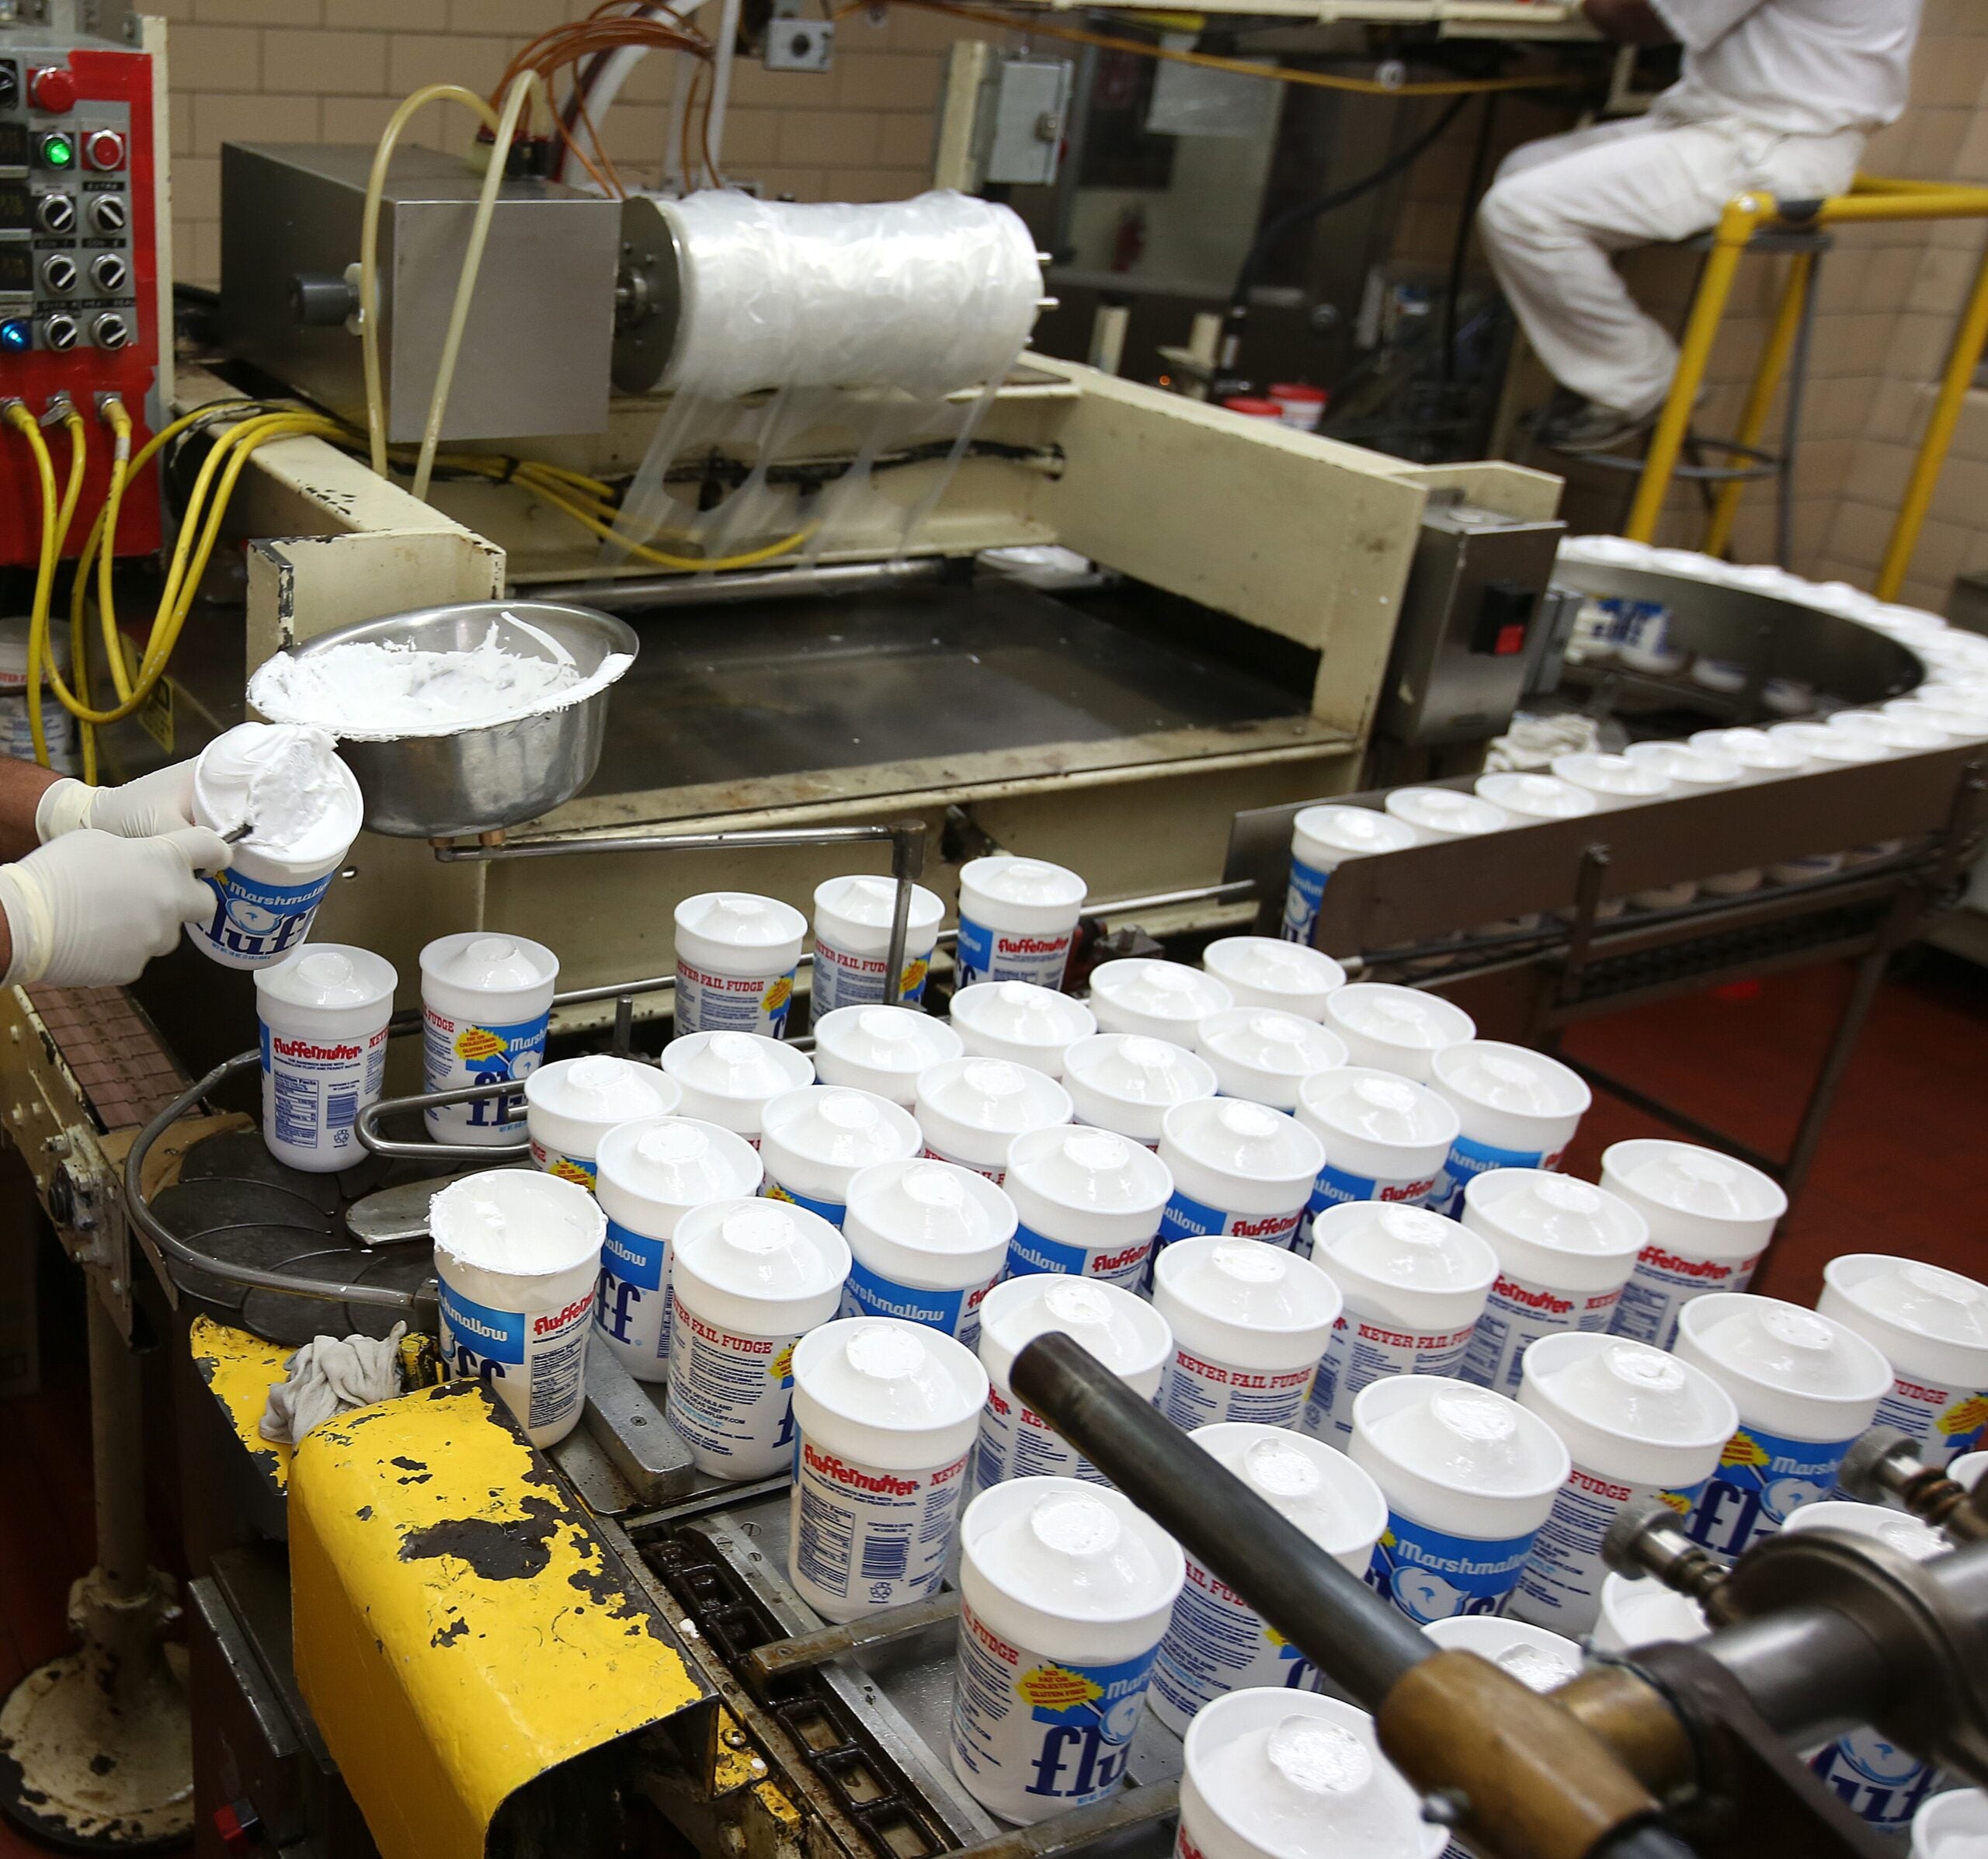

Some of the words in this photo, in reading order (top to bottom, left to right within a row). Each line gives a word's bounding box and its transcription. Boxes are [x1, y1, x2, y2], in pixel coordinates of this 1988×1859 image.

[837, 954, 860, 971] FAIL
[862, 961, 890, 973] FUD
[700, 973, 725, 989] FAIL
[727, 980, 765, 992] FUDGE
[428, 1010, 455, 1033] FUDGE
[1492, 1274, 1573, 1314] fernutter
[691, 1319, 719, 1344] FAIL
[721, 1335, 773, 1354] FUDGE
[1357, 1323, 1414, 1349] NEVER
[1416, 1336, 1448, 1350] FAIL
[1176, 1350, 1228, 1384] NEVER
[1230, 1372, 1267, 1389] FAIL
[805, 1444, 917, 1496] fluffernutter
[1567, 1469, 1632, 1502] FUDGE
[1684, 1480, 1777, 1557] fl
[973, 1618, 1020, 1666] FUDGE
[1024, 1725, 1130, 1798] flu
